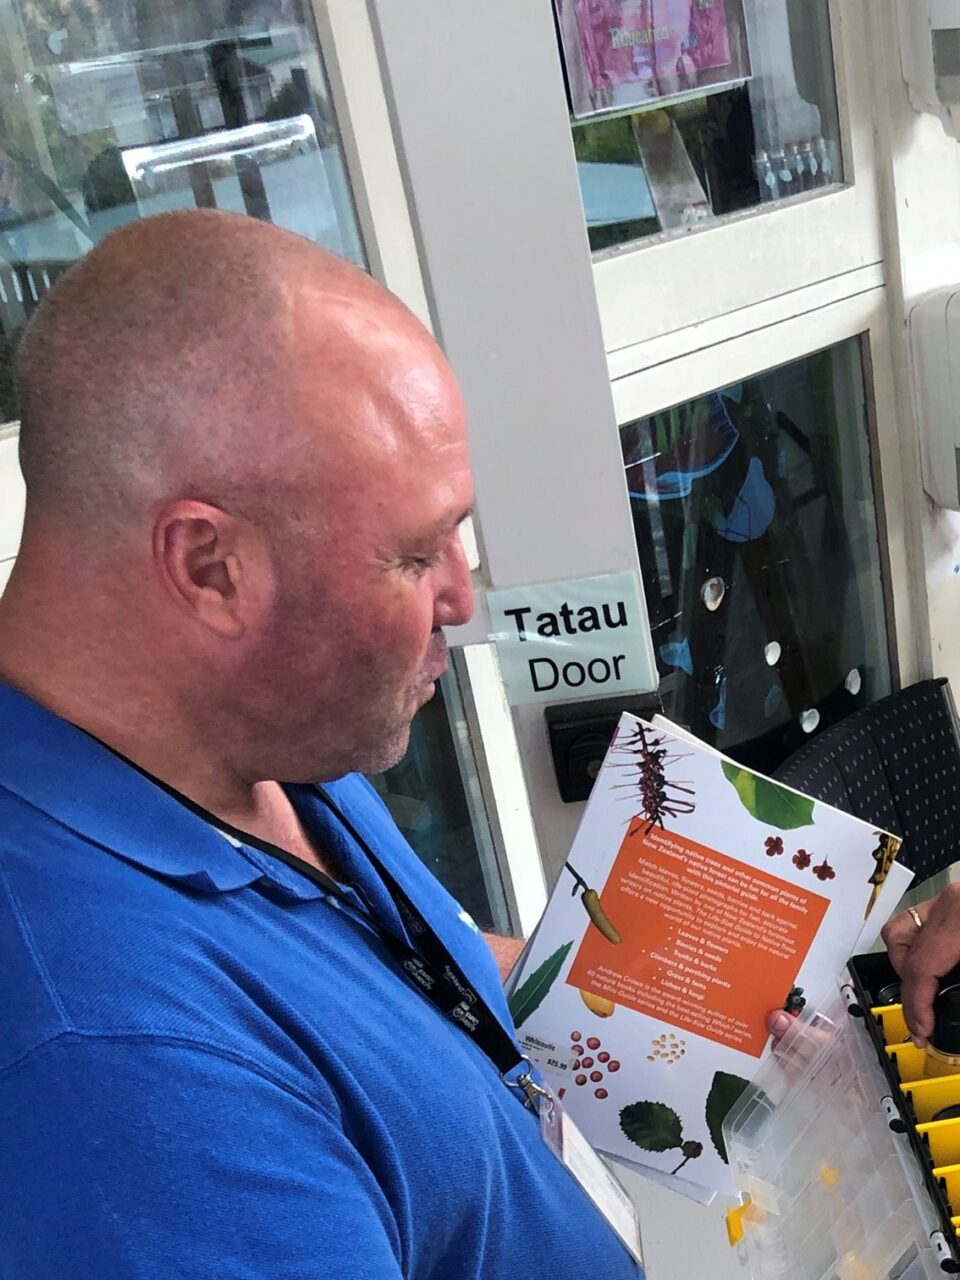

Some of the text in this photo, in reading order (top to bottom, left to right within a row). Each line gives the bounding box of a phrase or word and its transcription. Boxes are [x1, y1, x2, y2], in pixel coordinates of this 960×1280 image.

[504, 602, 628, 642] Tatau
[528, 654, 625, 692] Door
[641, 838, 657, 849] New
[688, 859, 708, 871] native
[708, 867, 727, 879] forest
[727, 876, 739, 884] can
[739, 880, 748, 888] be
[748, 884, 759, 892] fun
[778, 897, 789, 905] the
[789, 901, 808, 914] family
[650, 832, 684, 853] Identifying
[684, 849, 704, 860] native
[705, 857, 721, 868] trees
[721, 865, 735, 873] and
[734, 870, 751, 880] other
[752, 878, 779, 893] common
[779, 889, 799, 901] plants
[686, 867, 759, 901] with this pictorial guide.
[637, 857, 657, 870] Match
[727, 895, 748, 908] berries
[748, 905, 761, 913] and
[761, 910, 775, 919] bark
[775, 917, 798, 929] against
[671, 888, 693, 902] Written
[693, 898, 702, 906] by
[703, 903, 715, 911] one
[723, 910, 737, 921] New
[620, 877, 642, 889] writers
[652, 891, 672, 901] native
[696, 907, 707, 916] The
[734, 924, 752, 935] Guide
[760, 935, 780, 947] Native
[781, 943, 796, 954] Trees
[620, 886, 639, 897] offers
[645, 896, 658, 904] new
[659, 902, 694, 920] opportunity
[703, 920, 726, 932] explore
[739, 936, 757, 946] enjoy
[757, 942, 768, 950] the
[768, 947, 790, 959] natural
[663, 913, 682, 923] world
[702, 928, 720, 939] native
[721, 936, 742, 947] plants.
[699, 893, 738, 912] photographs
[762, 920, 788, 933] accurate
[675, 939, 697, 952] Berries
[704, 952, 722, 962] seeds
[677, 928, 699, 941] Leaves
[705, 940, 728, 954] flowers
[649, 951, 677, 967] Climbers
[683, 966, 711, 981] perching
[711, 977, 731, 988] plants
[673, 949, 693, 961] Trunks
[700, 960, 717, 971] barks
[595, 973, 616, 984] nature
[616, 981, 635, 992] books
[636, 990, 664, 1005] including
[665, 1000, 675, 1008] the
[597, 965, 623, 979] Andrew
[623, 975, 643, 987] Crowe
[650, 986, 661, 994] the
[707, 1009, 727, 1019] author
[734, 1020, 748, 1028] over
[660, 978, 681, 991] Lichen
[688, 989, 704, 1000] fungi
[666, 969, 684, 981] Grass
[691, 979, 706, 990] ferns
[590, 979, 601, 988] the
[602, 983, 617, 993] Mini
[617, 990, 636, 1001] Guide
[636, 998, 655, 1008] series
[655, 1006, 668, 1014] and
[668, 1010, 679, 1018] the
[705, 1024, 724, 1035] Guide
[547, 1058, 568, 1070] $25.99
